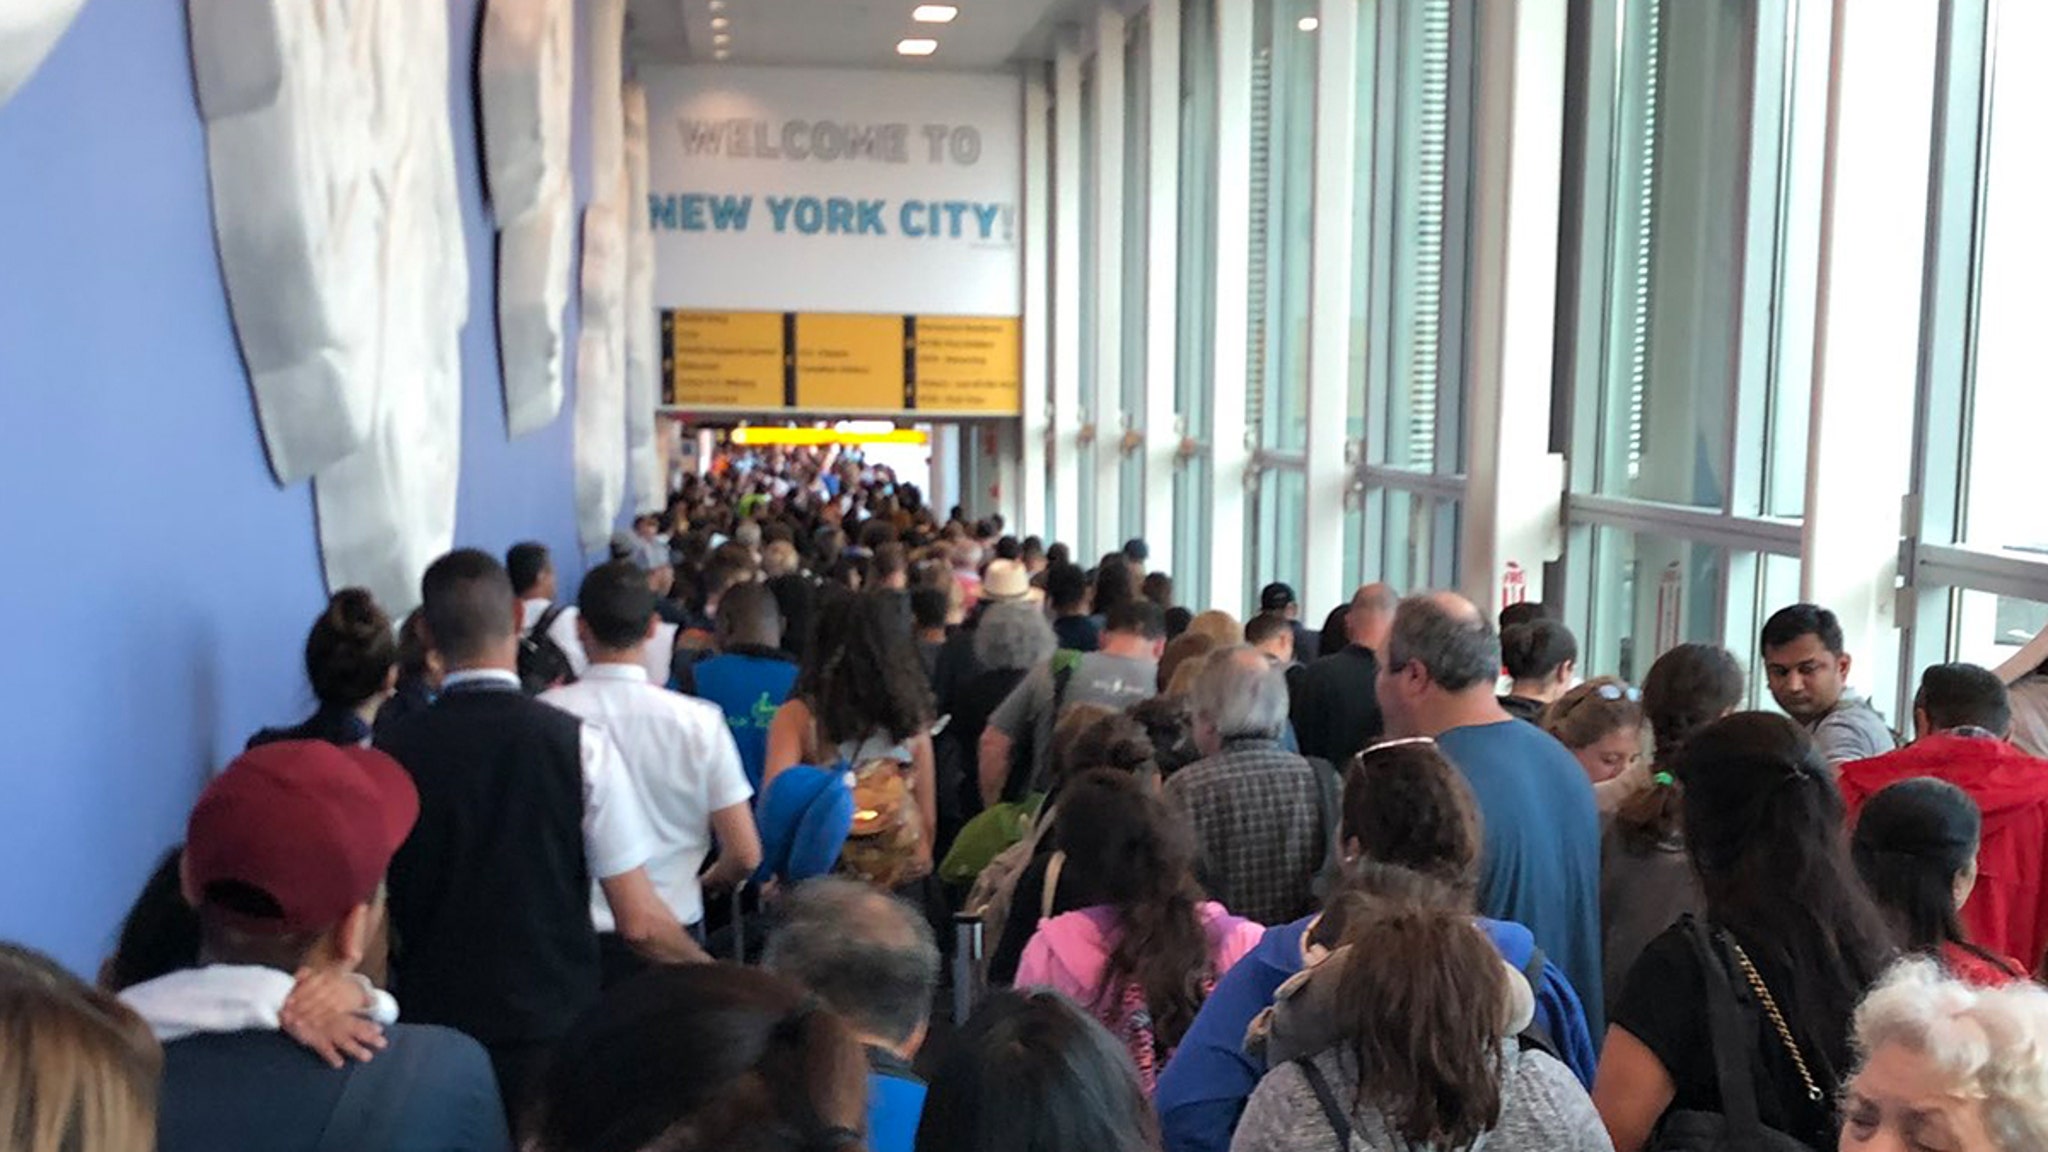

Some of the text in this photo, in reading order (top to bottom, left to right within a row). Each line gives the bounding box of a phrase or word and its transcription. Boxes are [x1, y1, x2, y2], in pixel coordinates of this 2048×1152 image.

[678, 118, 981, 165] WELCOME TO
[648, 193, 1015, 241] NEW YORK CITY!
